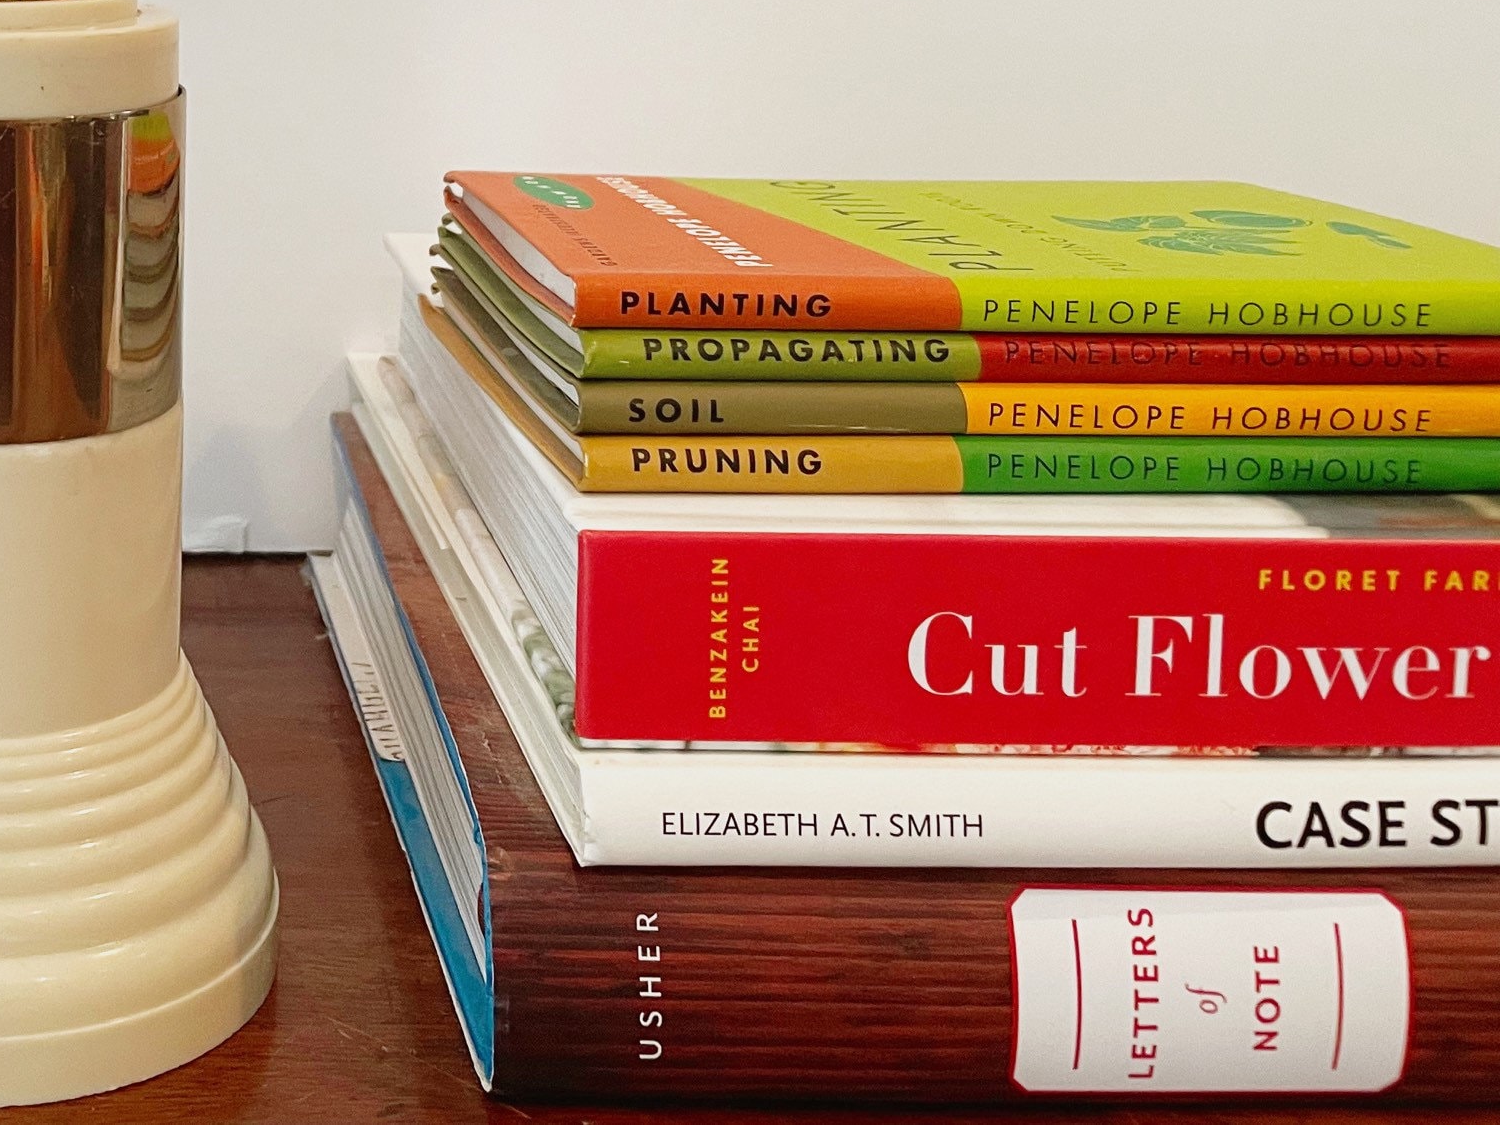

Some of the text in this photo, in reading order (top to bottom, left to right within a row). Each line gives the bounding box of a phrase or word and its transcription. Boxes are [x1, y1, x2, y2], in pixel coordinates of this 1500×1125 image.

[667, 218, 774, 267] PENELOPE
[769, 180, 1034, 271] PLANTING
[619, 291, 1433, 328] PLANTING PENELOPE HOBHOUSE
[643, 337, 1451, 368] PROPAGATING PENELOPE HOBHOUSE
[628, 397, 1433, 433] SOIL PENELOPE HOBHOUSE
[631, 448, 1421, 485] PRUNING PENELOPE HOBHOUSE
[1258, 569, 1500, 592] FLORET FAR
[708, 558, 729, 719] BENZAKEIN
[741, 605, 760, 673] CHAI
[907, 611, 1492, 701] Cut Flower
[661, 811, 819, 838] ELIZABETH
[888, 813, 984, 839] SMITH
[1255, 800, 1408, 849] CASE
[1429, 799, 1500, 847] ST
[636, 912, 663, 1060] USHER
[1127, 908, 1160, 1079] LETTERS
[1184, 982, 1228, 1015] of
[1253, 945, 1281, 1051] NOTE
